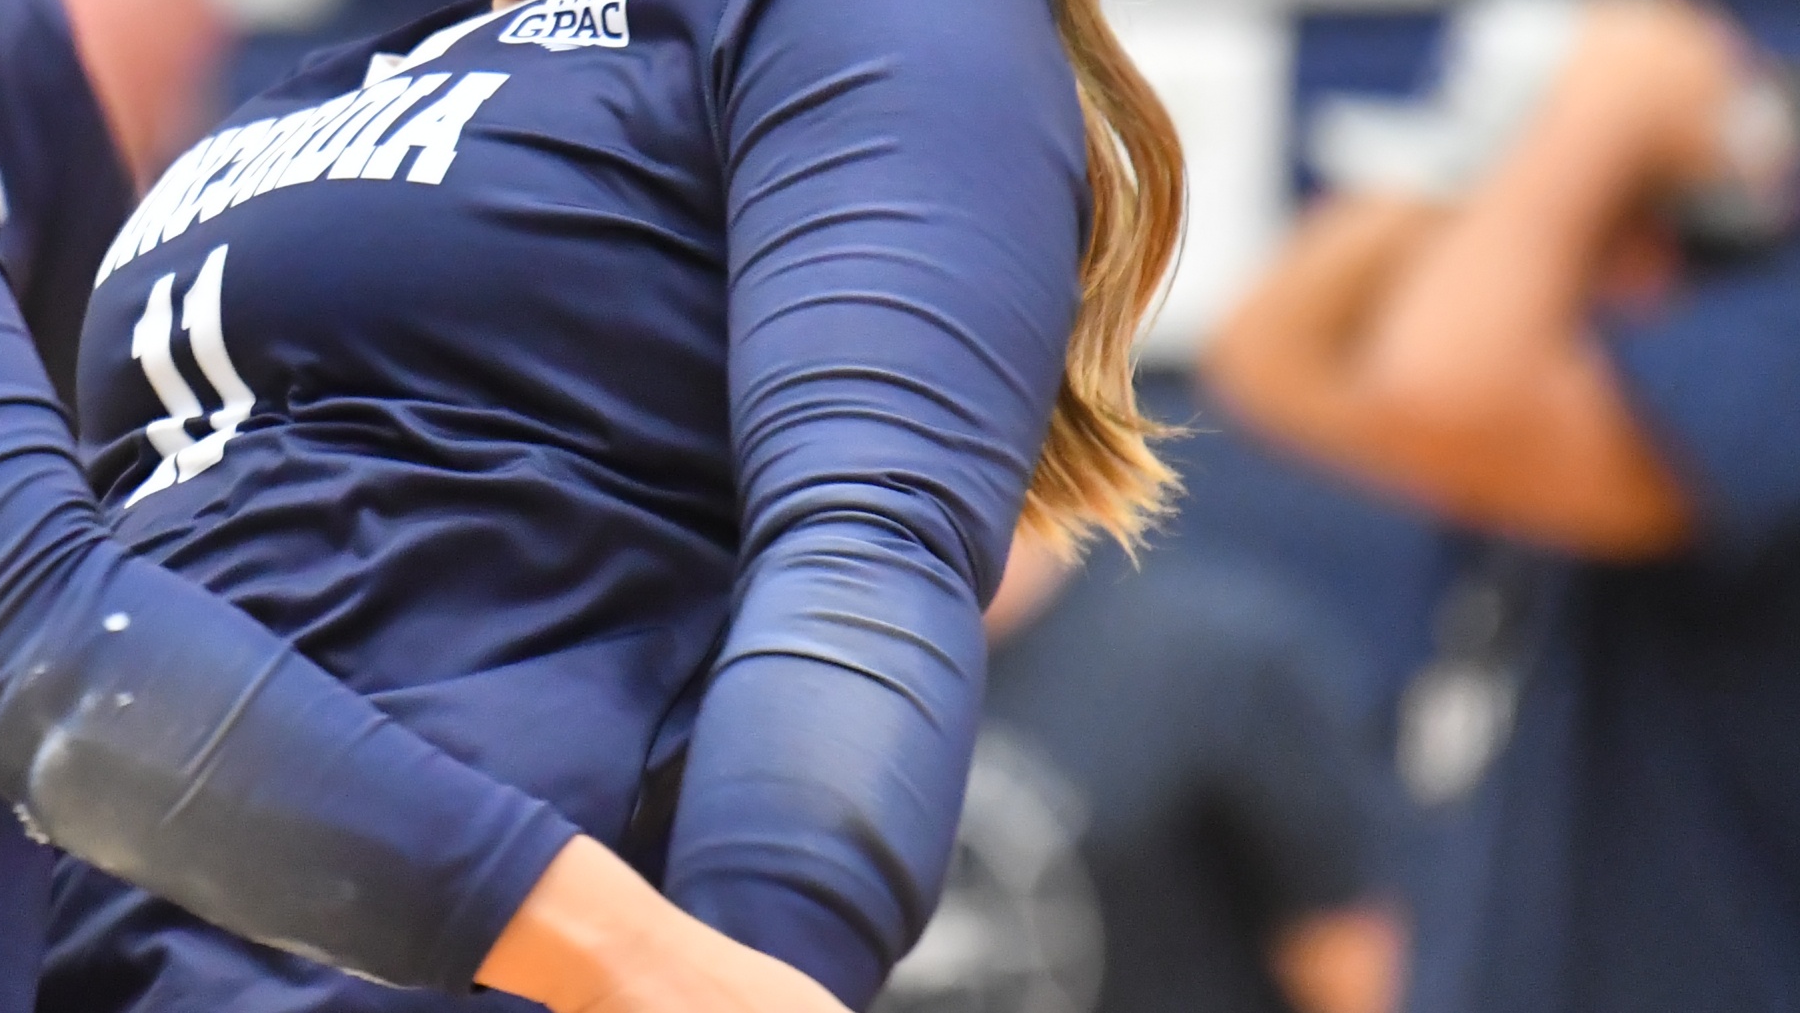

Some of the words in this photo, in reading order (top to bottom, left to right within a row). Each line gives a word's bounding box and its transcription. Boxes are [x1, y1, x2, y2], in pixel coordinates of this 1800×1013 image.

[507, 0, 625, 41] GPAC
[93, 71, 511, 292] NCORDIA
[123, 242, 257, 509] 11
